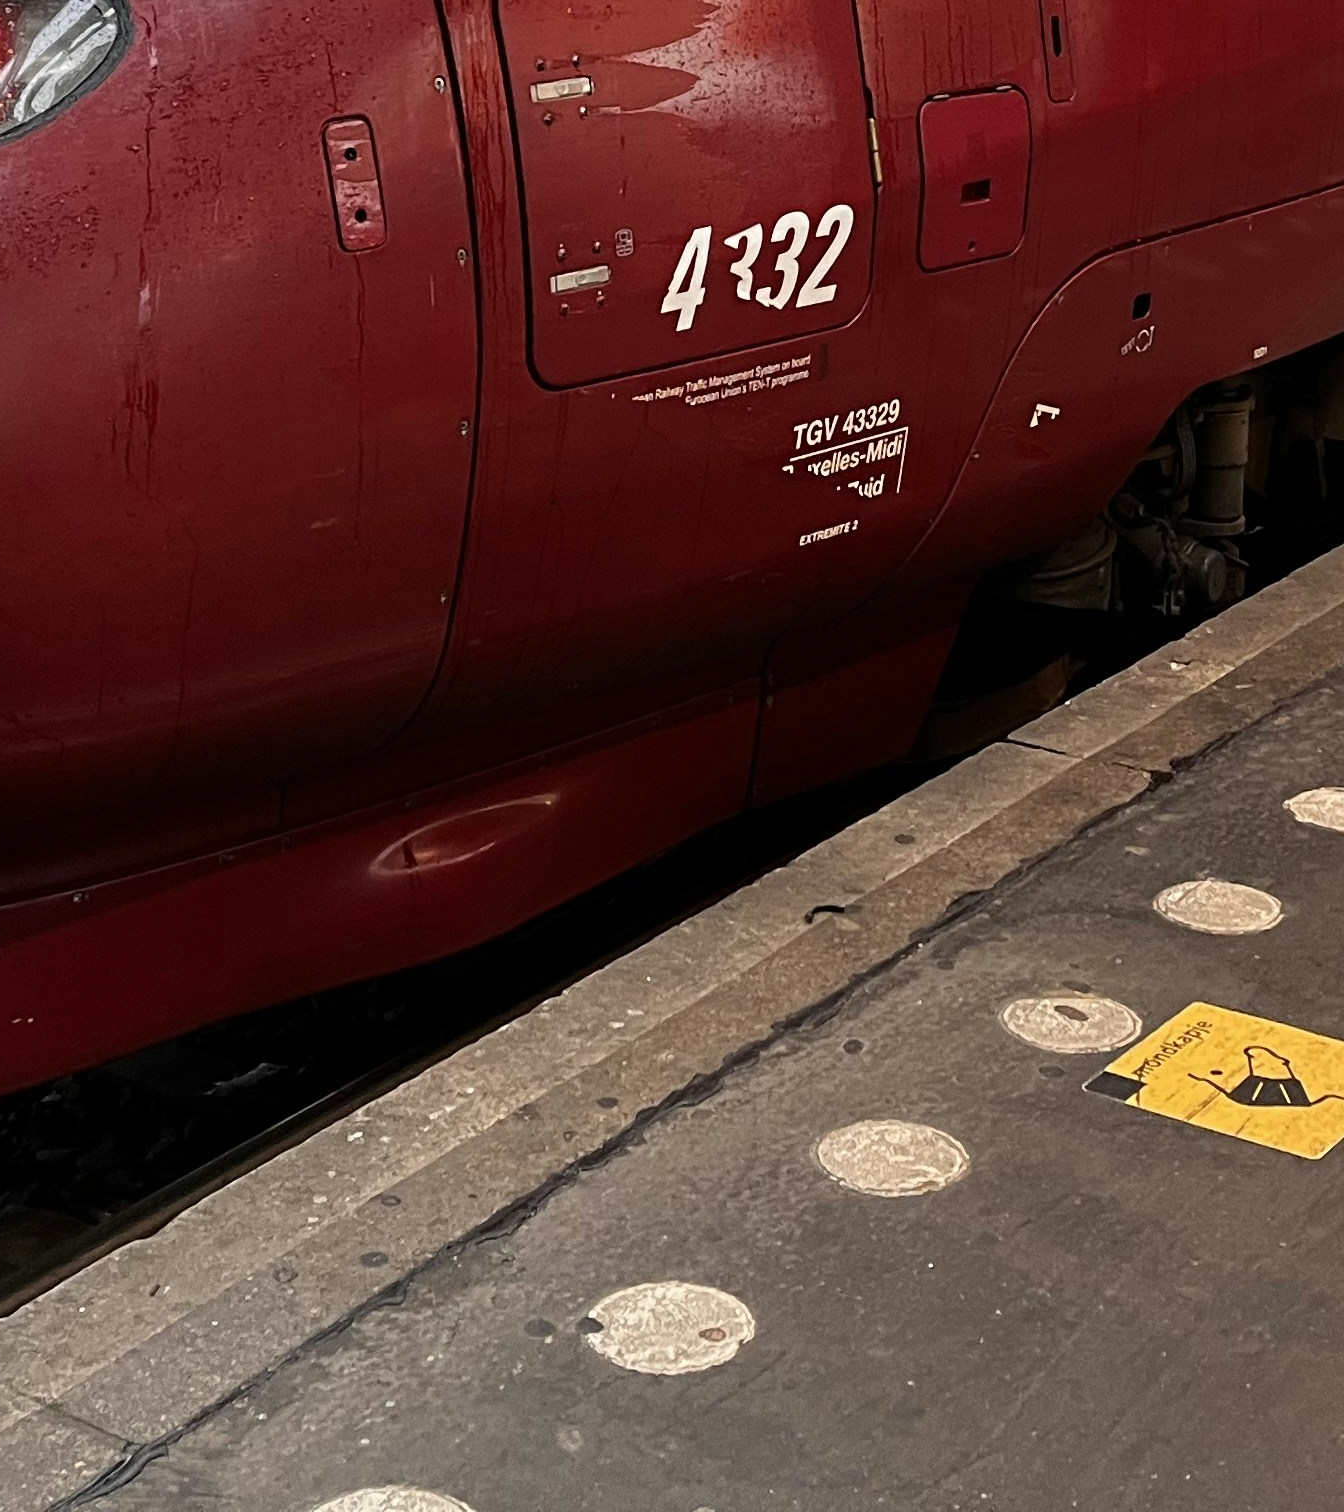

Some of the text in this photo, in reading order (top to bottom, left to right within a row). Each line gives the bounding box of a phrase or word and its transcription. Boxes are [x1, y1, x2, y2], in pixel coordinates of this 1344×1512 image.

[660, 204, 854, 332] 4332
[685, 380, 708, 394] Traffic
[708, 369, 755, 388] Management
[755, 363, 781, 378] System
[791, 354, 811, 369] board
[771, 369, 810, 389] programme
[793, 398, 901, 450] TGV 43329
[799, 521, 851, 546] EXTREMITE
